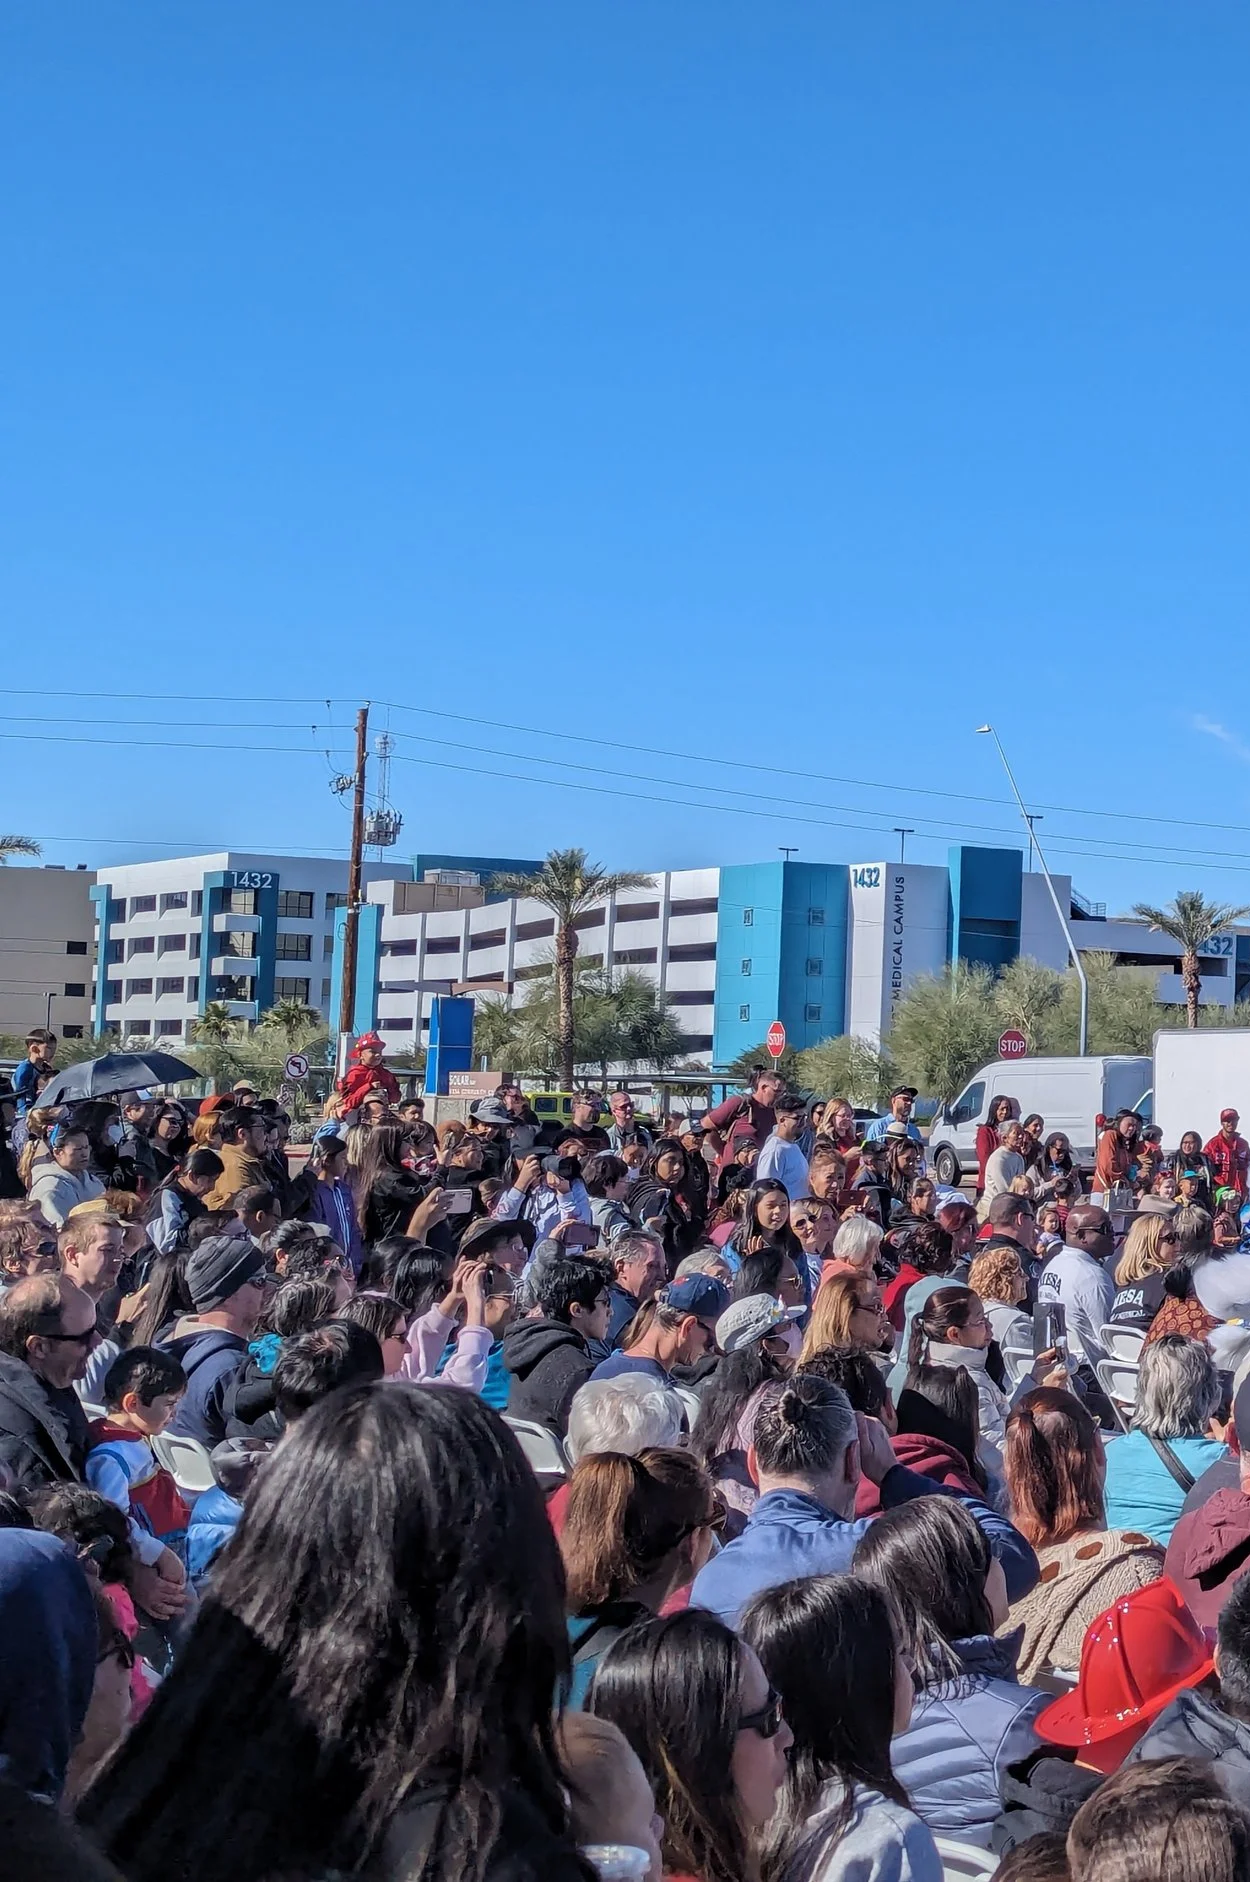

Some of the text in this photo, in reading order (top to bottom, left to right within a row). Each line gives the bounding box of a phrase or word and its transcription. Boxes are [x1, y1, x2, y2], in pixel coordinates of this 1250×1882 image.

[231, 871, 272, 889] 1432
[852, 866, 881, 888] 1432
[893, 876, 905, 935] CAMPUS
[1199, 935, 1233, 956] 432
[891, 939, 903, 1001] MEDICAL
[1000, 1039, 1025, 1052] STOP
